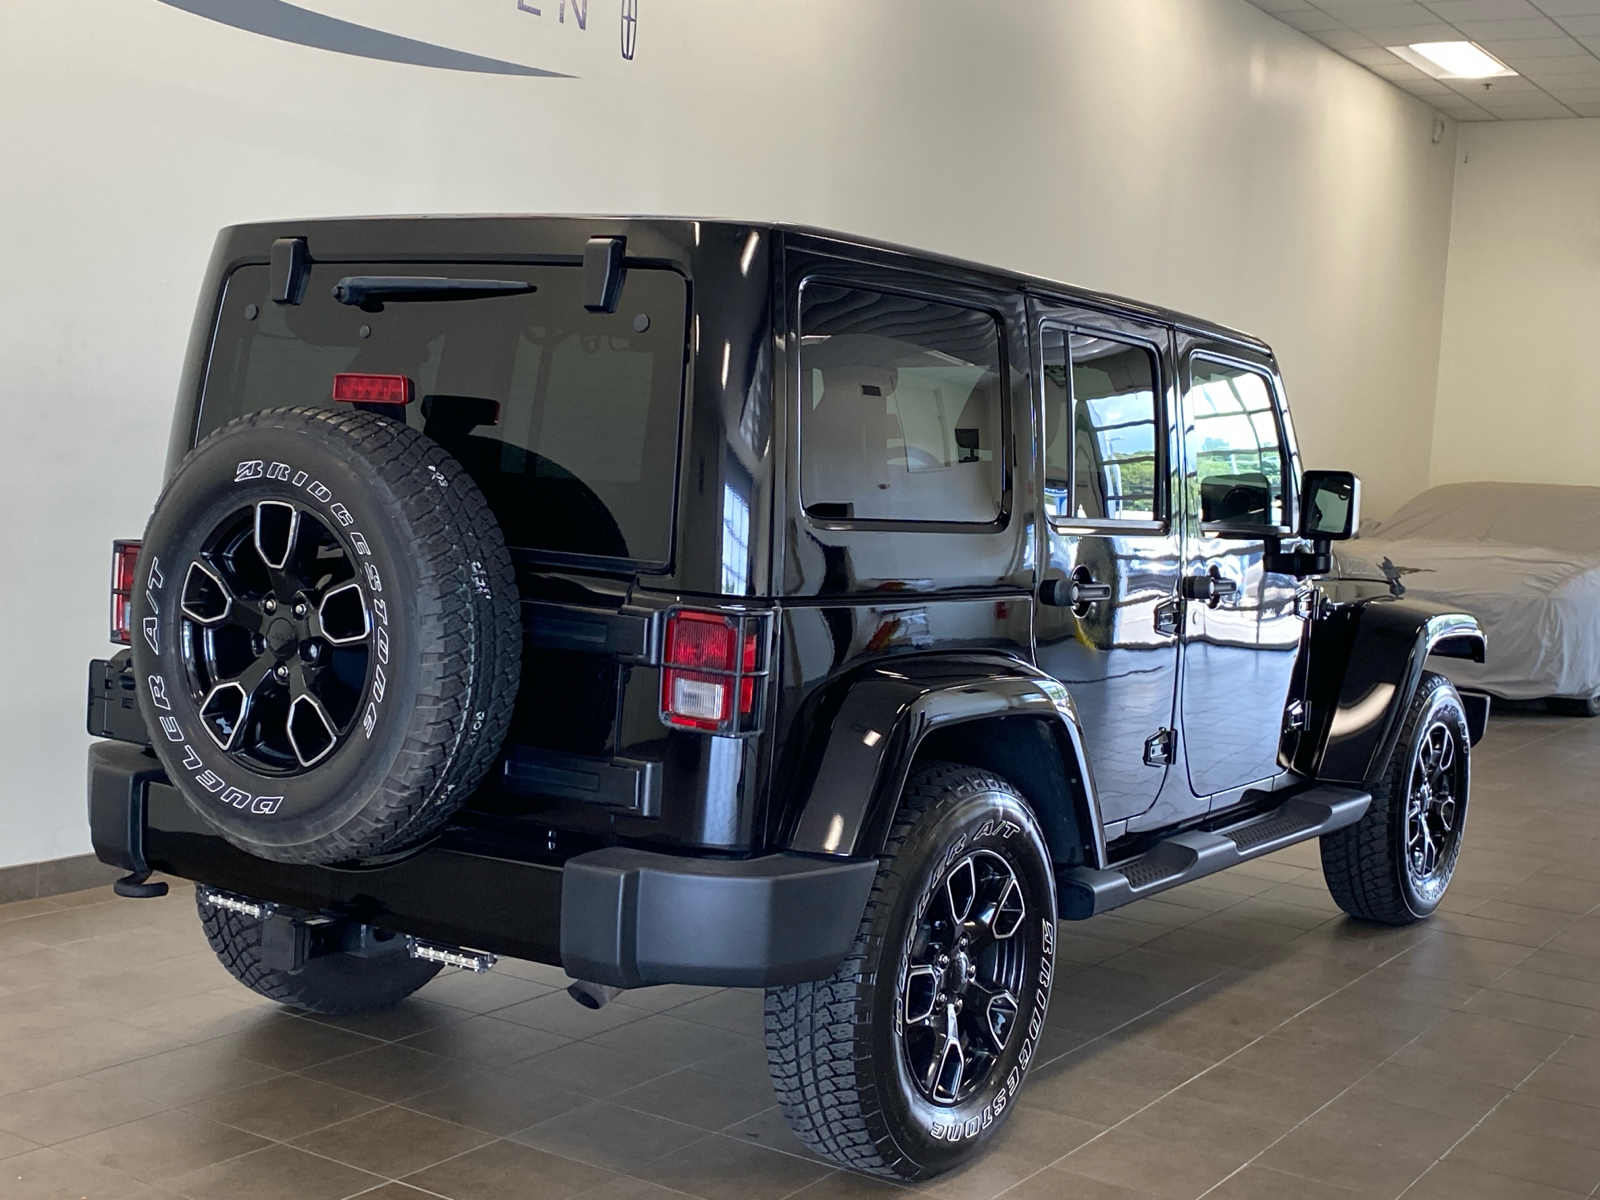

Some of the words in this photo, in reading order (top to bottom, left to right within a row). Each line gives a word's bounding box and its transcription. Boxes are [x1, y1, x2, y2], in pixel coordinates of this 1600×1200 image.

[142, 556, 166, 657] A/T
[234, 459, 390, 741] BRIDGESTONE
[147, 675, 285, 815] DUELER
[972, 818, 1021, 841] A/T
[930, 917, 1054, 1143] BRIDGESTONE
